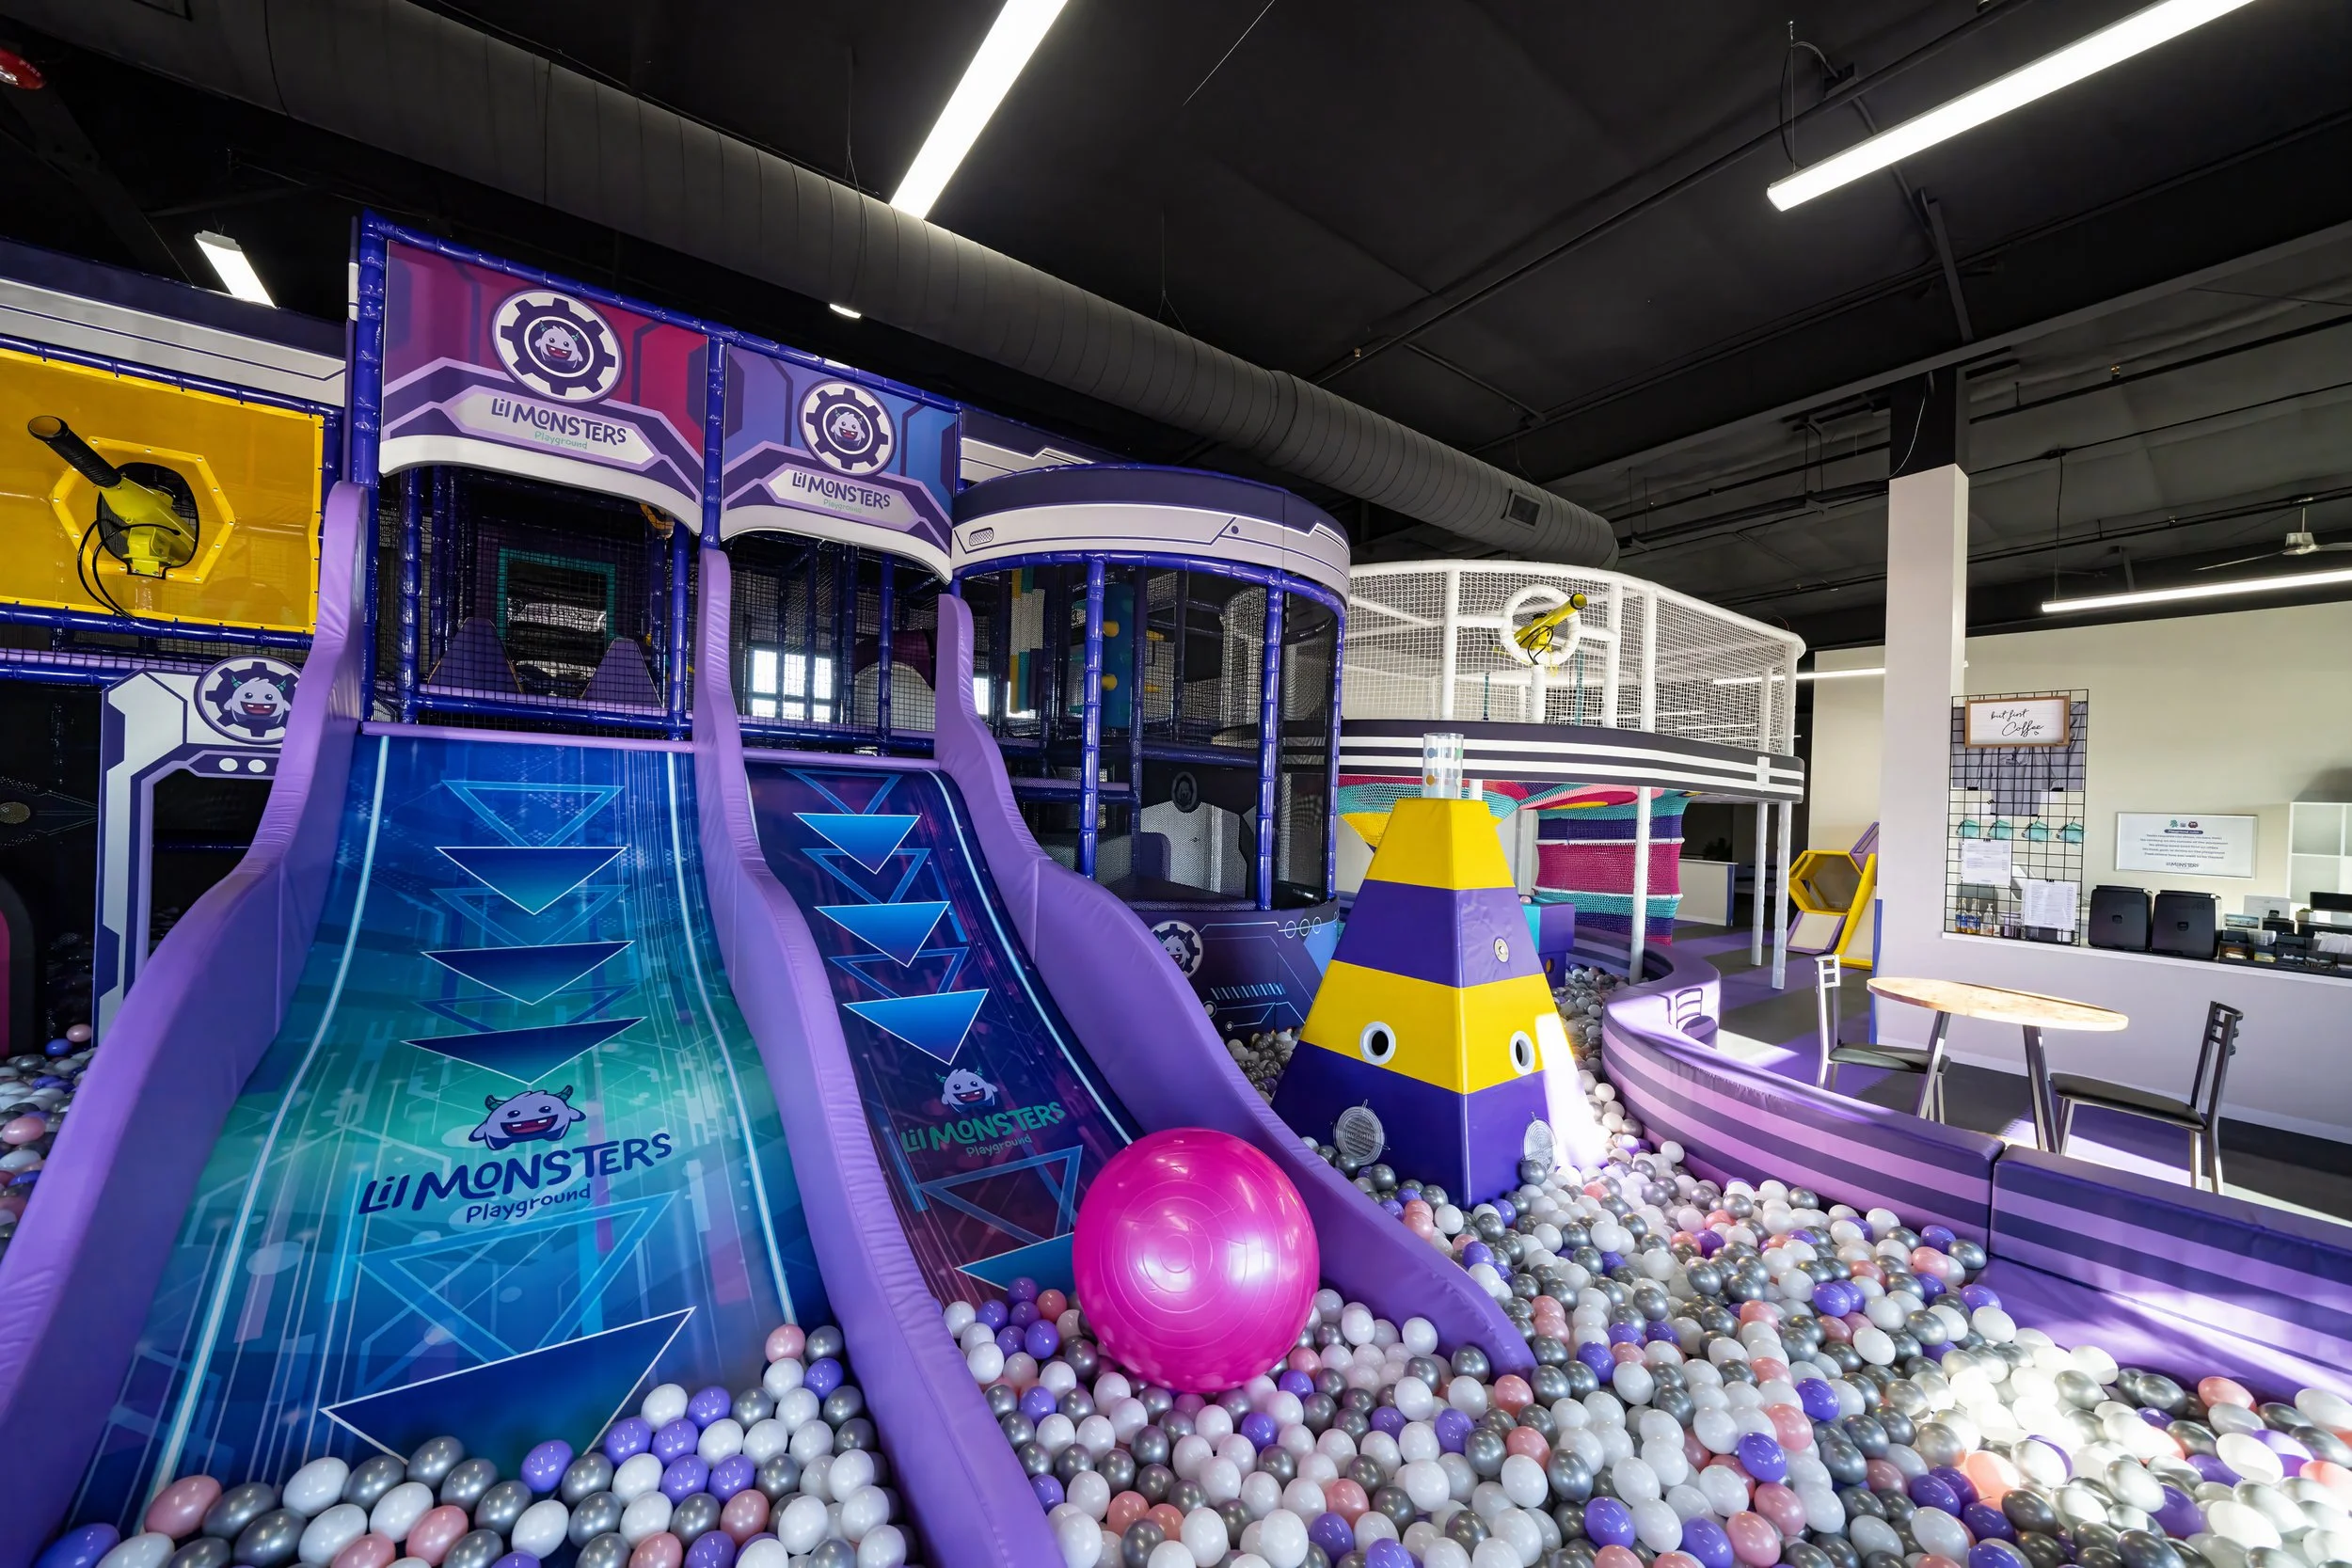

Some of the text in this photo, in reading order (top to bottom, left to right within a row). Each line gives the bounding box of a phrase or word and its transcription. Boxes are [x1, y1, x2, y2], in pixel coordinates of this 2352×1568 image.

[491, 398, 627, 446] Lil MONSTERS
[534, 431, 588, 450] Playground
[792, 471, 891, 509] Lil MONSTERS
[2001, 721, 2044, 737] Coffee
[901, 1101, 1066, 1153] Lil MONSTERS
[966, 1134, 1032, 1158] Playground
[358, 1132, 673, 1214] Lil MONSTERS
[466, 1182, 591, 1224] Playground
